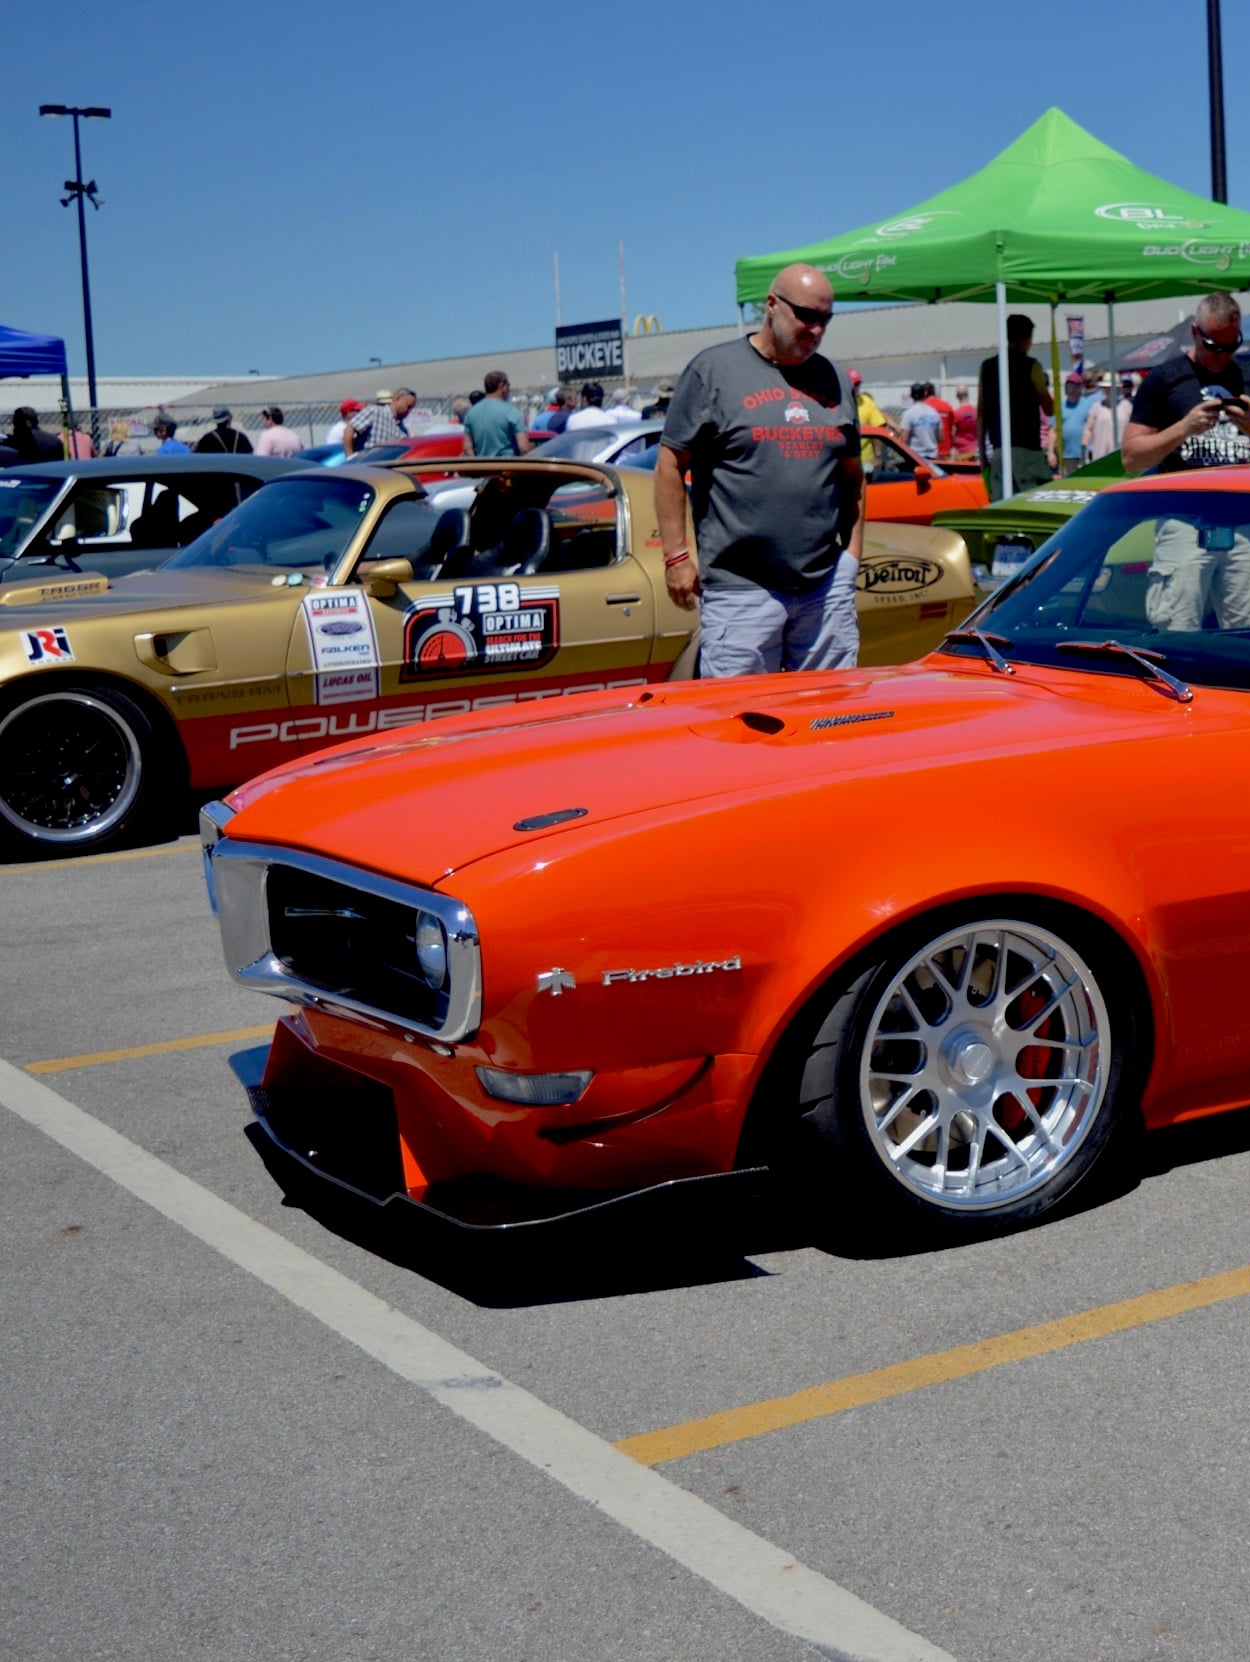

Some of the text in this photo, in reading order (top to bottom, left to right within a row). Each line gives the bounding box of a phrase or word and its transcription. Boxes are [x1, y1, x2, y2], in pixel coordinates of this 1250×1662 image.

[1143, 246, 1181, 256] BUD
[1189, 245, 1236, 255] LIGHT
[557, 340, 622, 372] BUCKEYE
[743, 387, 785, 410] OHIO
[859, 562, 932, 590] Detroit
[311, 597, 357, 611] OPTIMA
[455, 584, 520, 616] 738
[486, 613, 541, 631] OPTIMA
[322, 643, 370, 655] FALKEN
[323, 672, 372, 688] LUCAS OIL
[602, 955, 742, 987] Firebird
